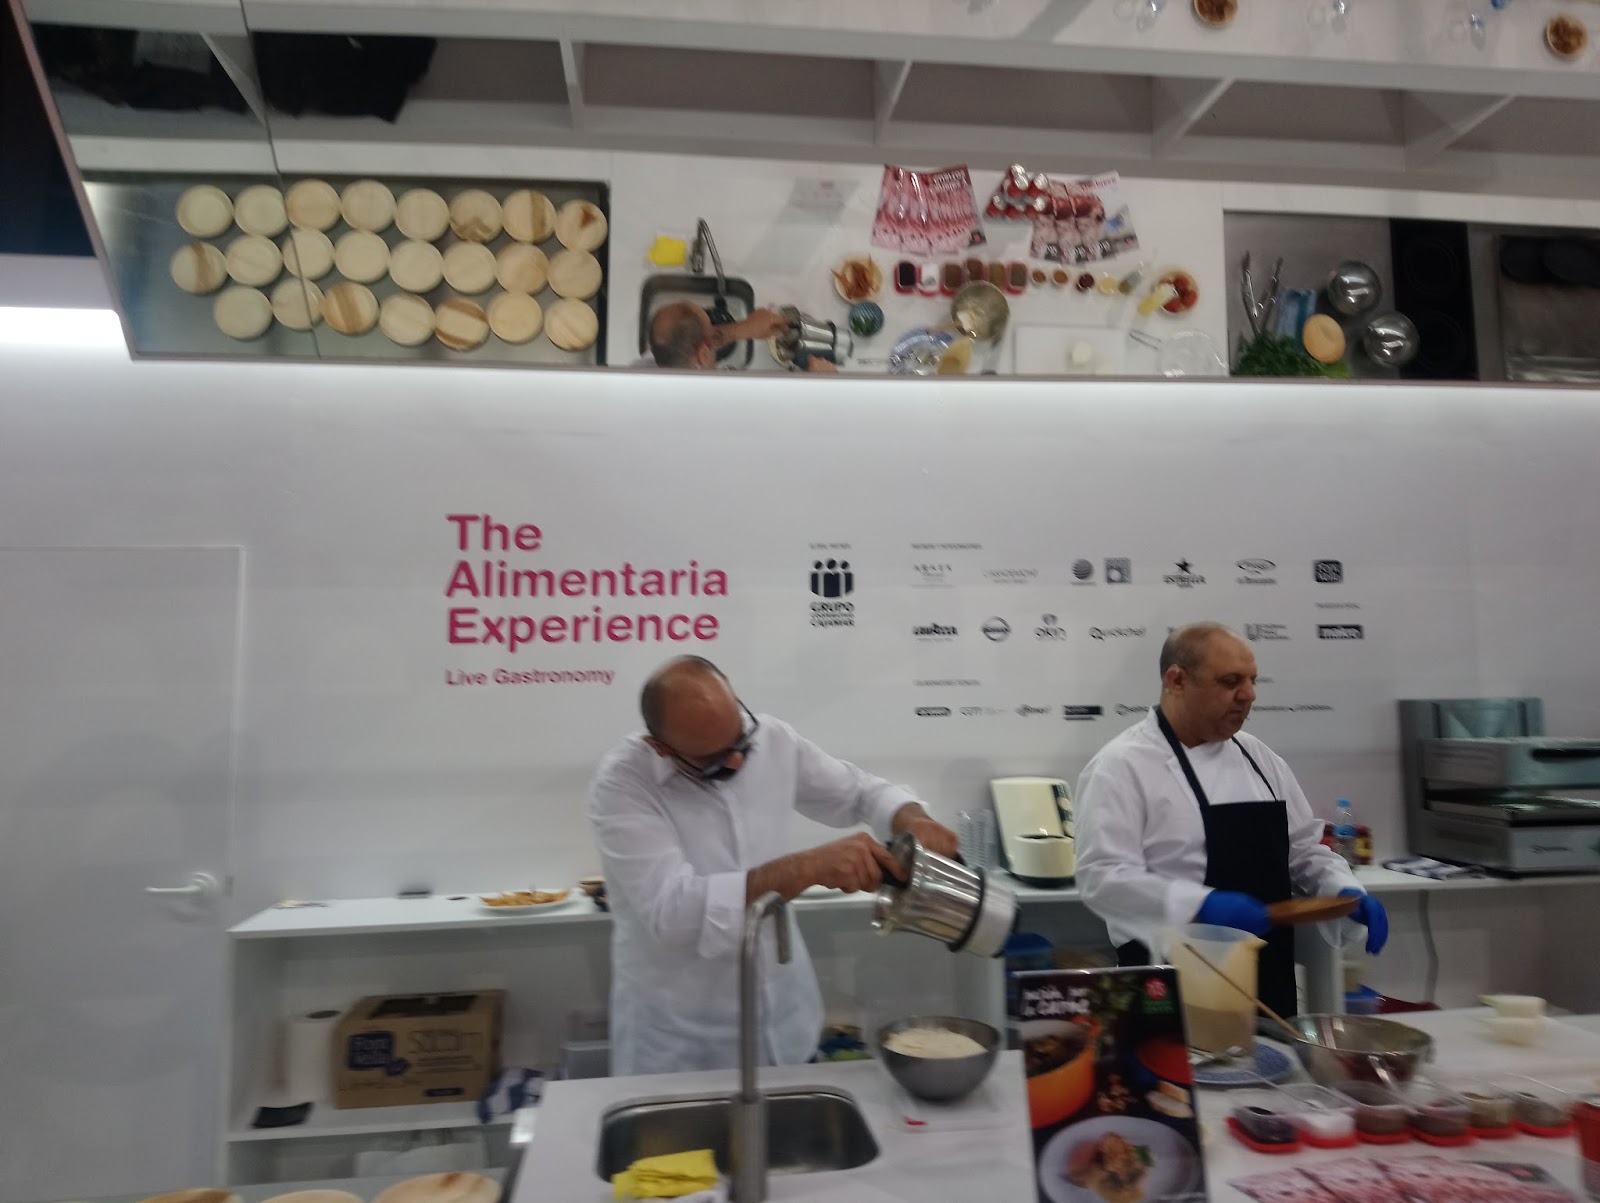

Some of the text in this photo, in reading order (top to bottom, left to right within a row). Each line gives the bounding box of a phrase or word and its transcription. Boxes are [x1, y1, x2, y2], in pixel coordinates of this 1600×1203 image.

[446, 513, 544, 551] The
[445, 560, 729, 598] Alimentaria
[447, 606, 721, 653] Experience
[446, 668, 616, 686] Live Gastronomy
